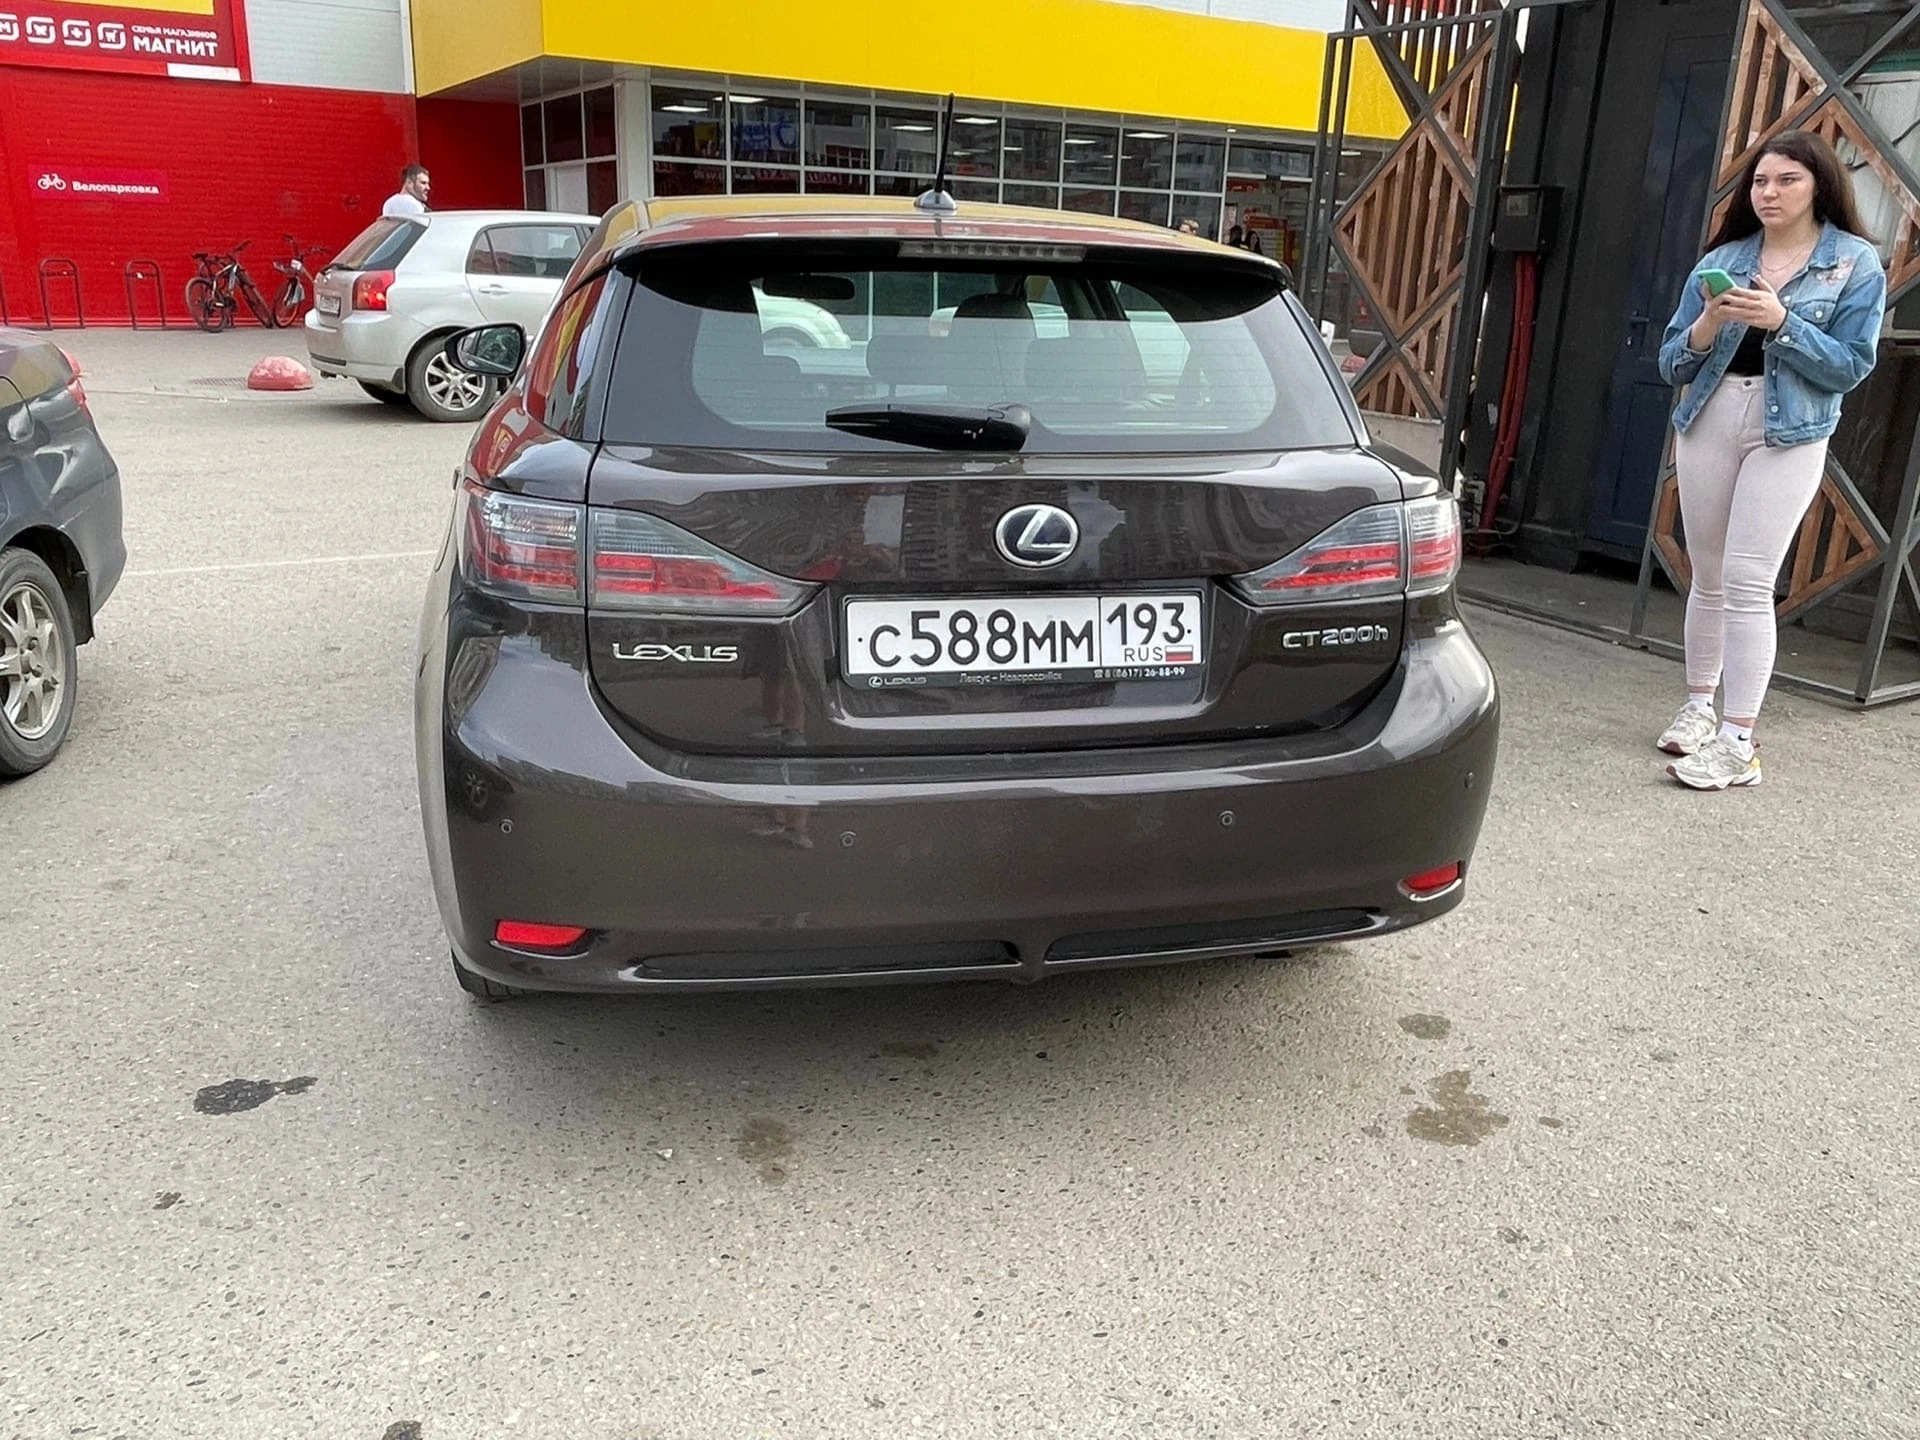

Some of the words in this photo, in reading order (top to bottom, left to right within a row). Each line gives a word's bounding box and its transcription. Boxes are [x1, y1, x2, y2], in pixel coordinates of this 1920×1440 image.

[131, 25, 162, 35] СЕМЬЯ
[162, 28, 217, 39] МАГАЗИНОВ
[132, 35, 218, 57] МАГНИТ
[72, 180, 160, 195] Велопарковка
[869, 608, 1094, 668] С588ММ
[1106, 602, 1186, 646] 193
[611, 642, 739, 663] LEXUS
[1123, 646, 1164, 663] RUS
[1144, 666, 1186, 678] 26-88-99
